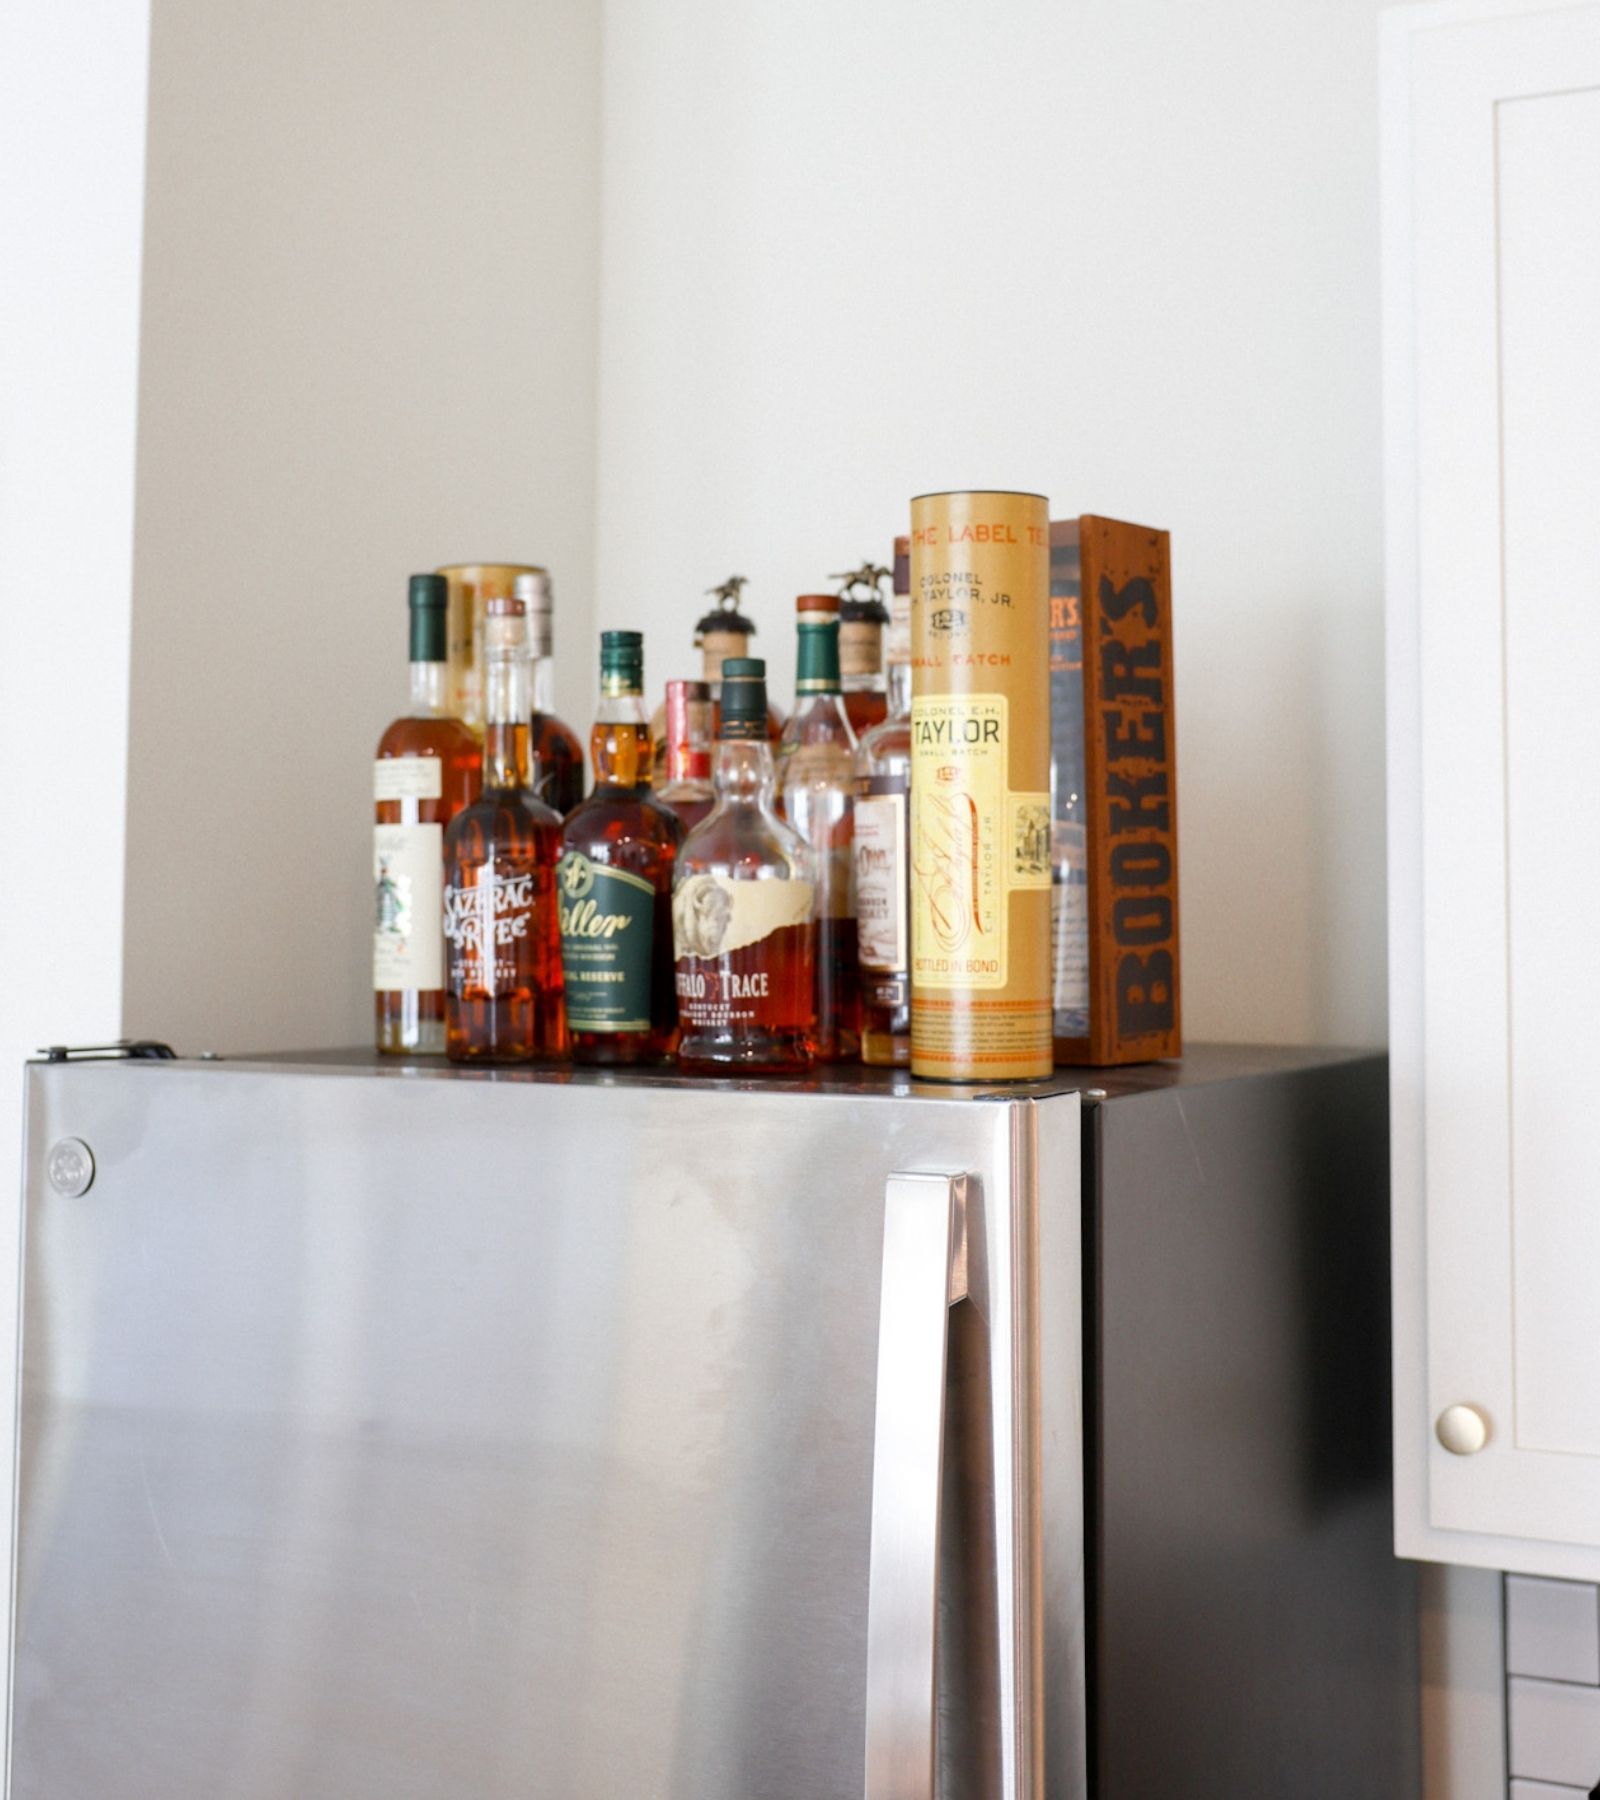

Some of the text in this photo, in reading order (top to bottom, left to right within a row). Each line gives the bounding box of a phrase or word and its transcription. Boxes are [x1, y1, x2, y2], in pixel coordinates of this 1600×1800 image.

[949, 523, 1018, 544] LABEL
[920, 572, 983, 588] COLONEL
[990, 593, 1015, 609] JR.
[914, 719, 1000, 744] TAYLOR
[1100, 575, 1174, 1041] BOOKER'S
[559, 897, 632, 938] eller
[966, 960, 998, 973] BOND
[720, 970, 769, 1000] TRACE
